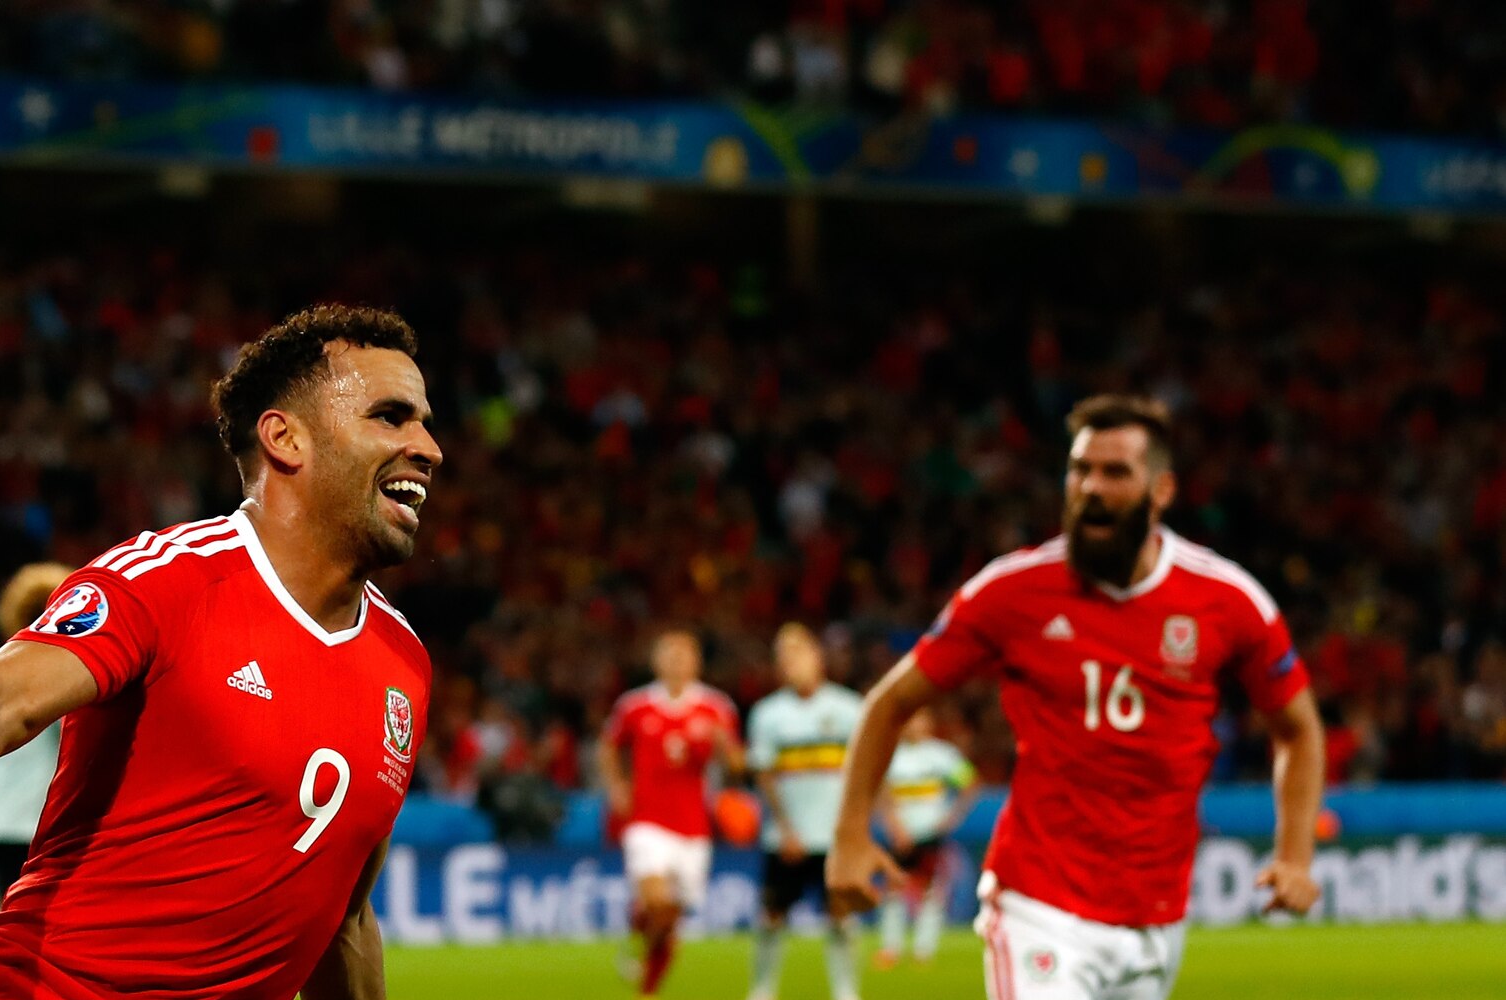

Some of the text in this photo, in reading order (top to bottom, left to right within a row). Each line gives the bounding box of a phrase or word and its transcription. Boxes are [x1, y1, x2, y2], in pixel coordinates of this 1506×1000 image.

[226, 676, 273, 700] adidas
[1081, 659, 1146, 733] 16
[293, 747, 351, 854] 9
